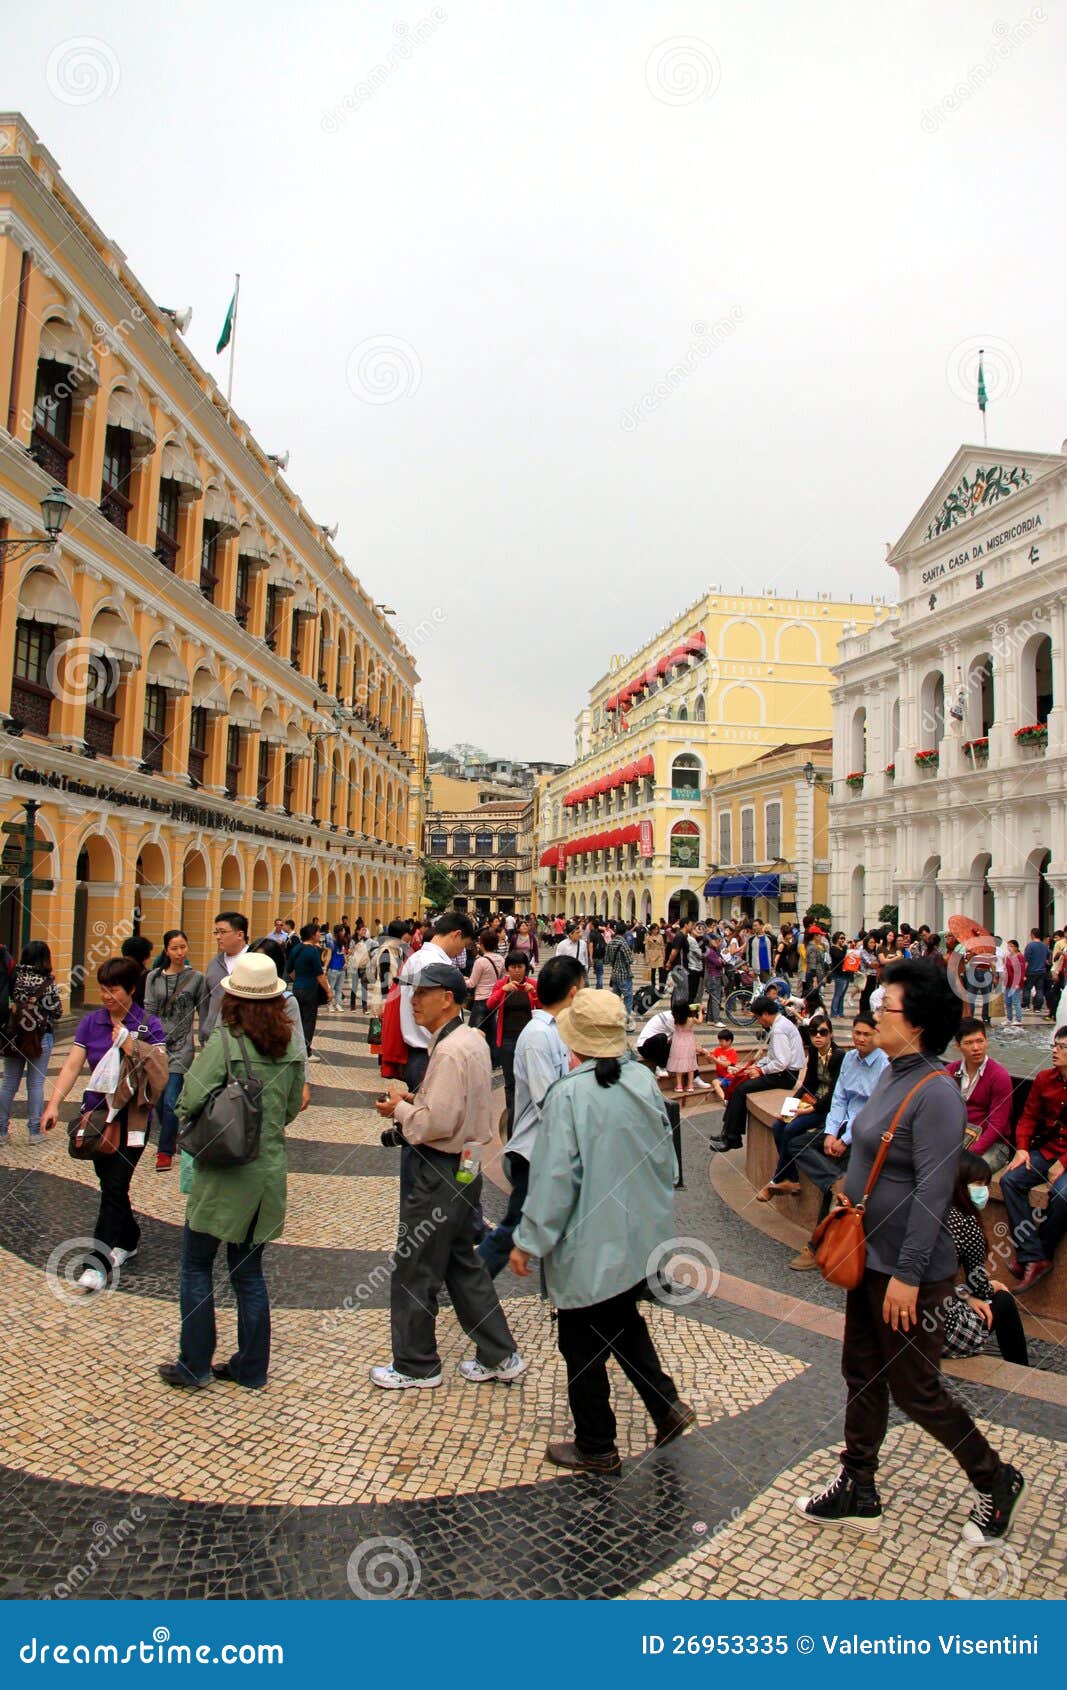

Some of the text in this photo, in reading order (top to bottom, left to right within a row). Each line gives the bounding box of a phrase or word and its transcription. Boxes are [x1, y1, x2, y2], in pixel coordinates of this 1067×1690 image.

[922, 514, 1042, 583] SANTA CASA DA MISERICORDIA
